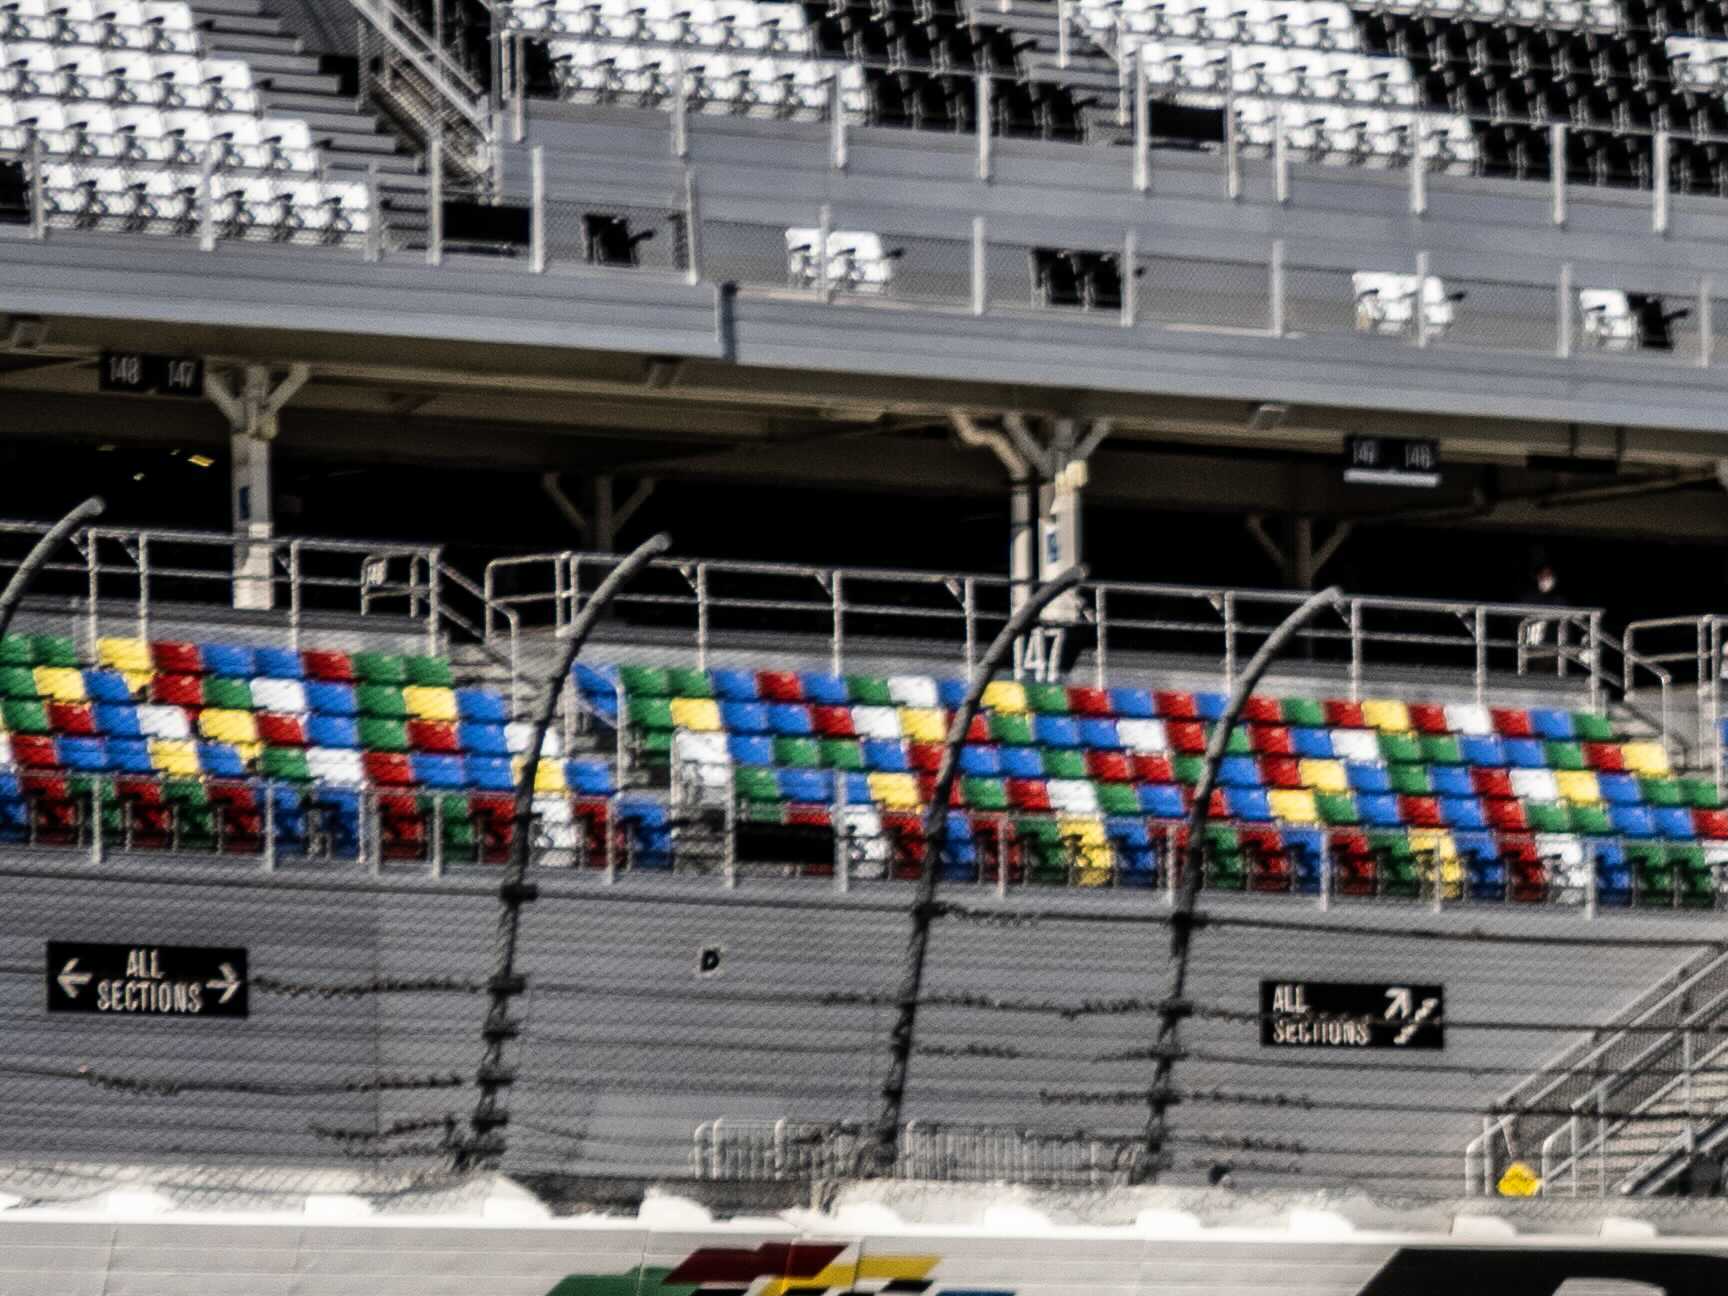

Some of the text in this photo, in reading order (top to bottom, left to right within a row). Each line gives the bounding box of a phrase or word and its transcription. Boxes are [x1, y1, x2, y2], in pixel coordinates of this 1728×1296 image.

[1013, 626, 1066, 683] 147
[126, 949, 165, 979] ALL
[97, 979, 203, 1013] SECTIONS
[1273, 984, 1311, 1013] ALL
